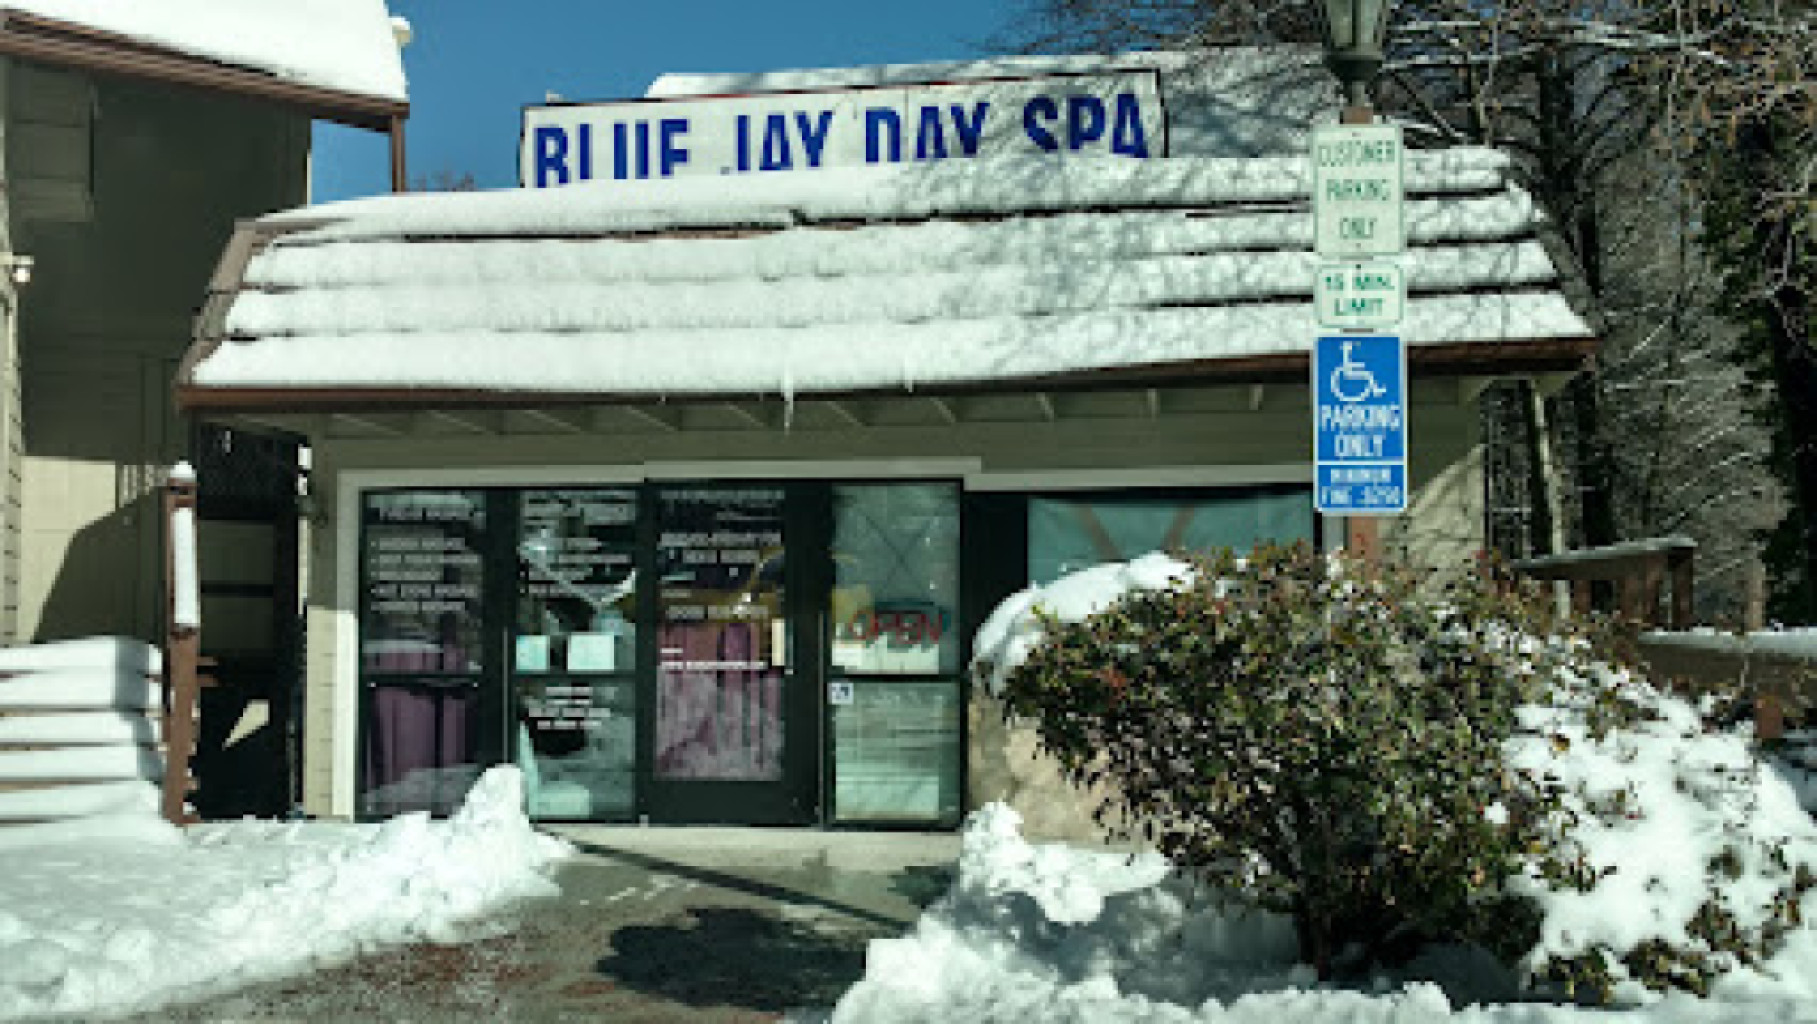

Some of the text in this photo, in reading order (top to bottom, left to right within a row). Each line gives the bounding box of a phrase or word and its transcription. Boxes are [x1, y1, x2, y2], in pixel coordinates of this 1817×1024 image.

[533, 93, 1150, 188] BLUE JAY DAY SPA
[1317, 140, 1396, 167] CUSTOMER
[1326, 179, 1391, 201] PARKING
[1339, 217, 1378, 240] ONLY
[1333, 298, 1384, 316] LIMIT
[1321, 404, 1400, 431] PARKING
[1333, 434, 1384, 457] ONLY
[847, 609, 943, 645] OPEN
